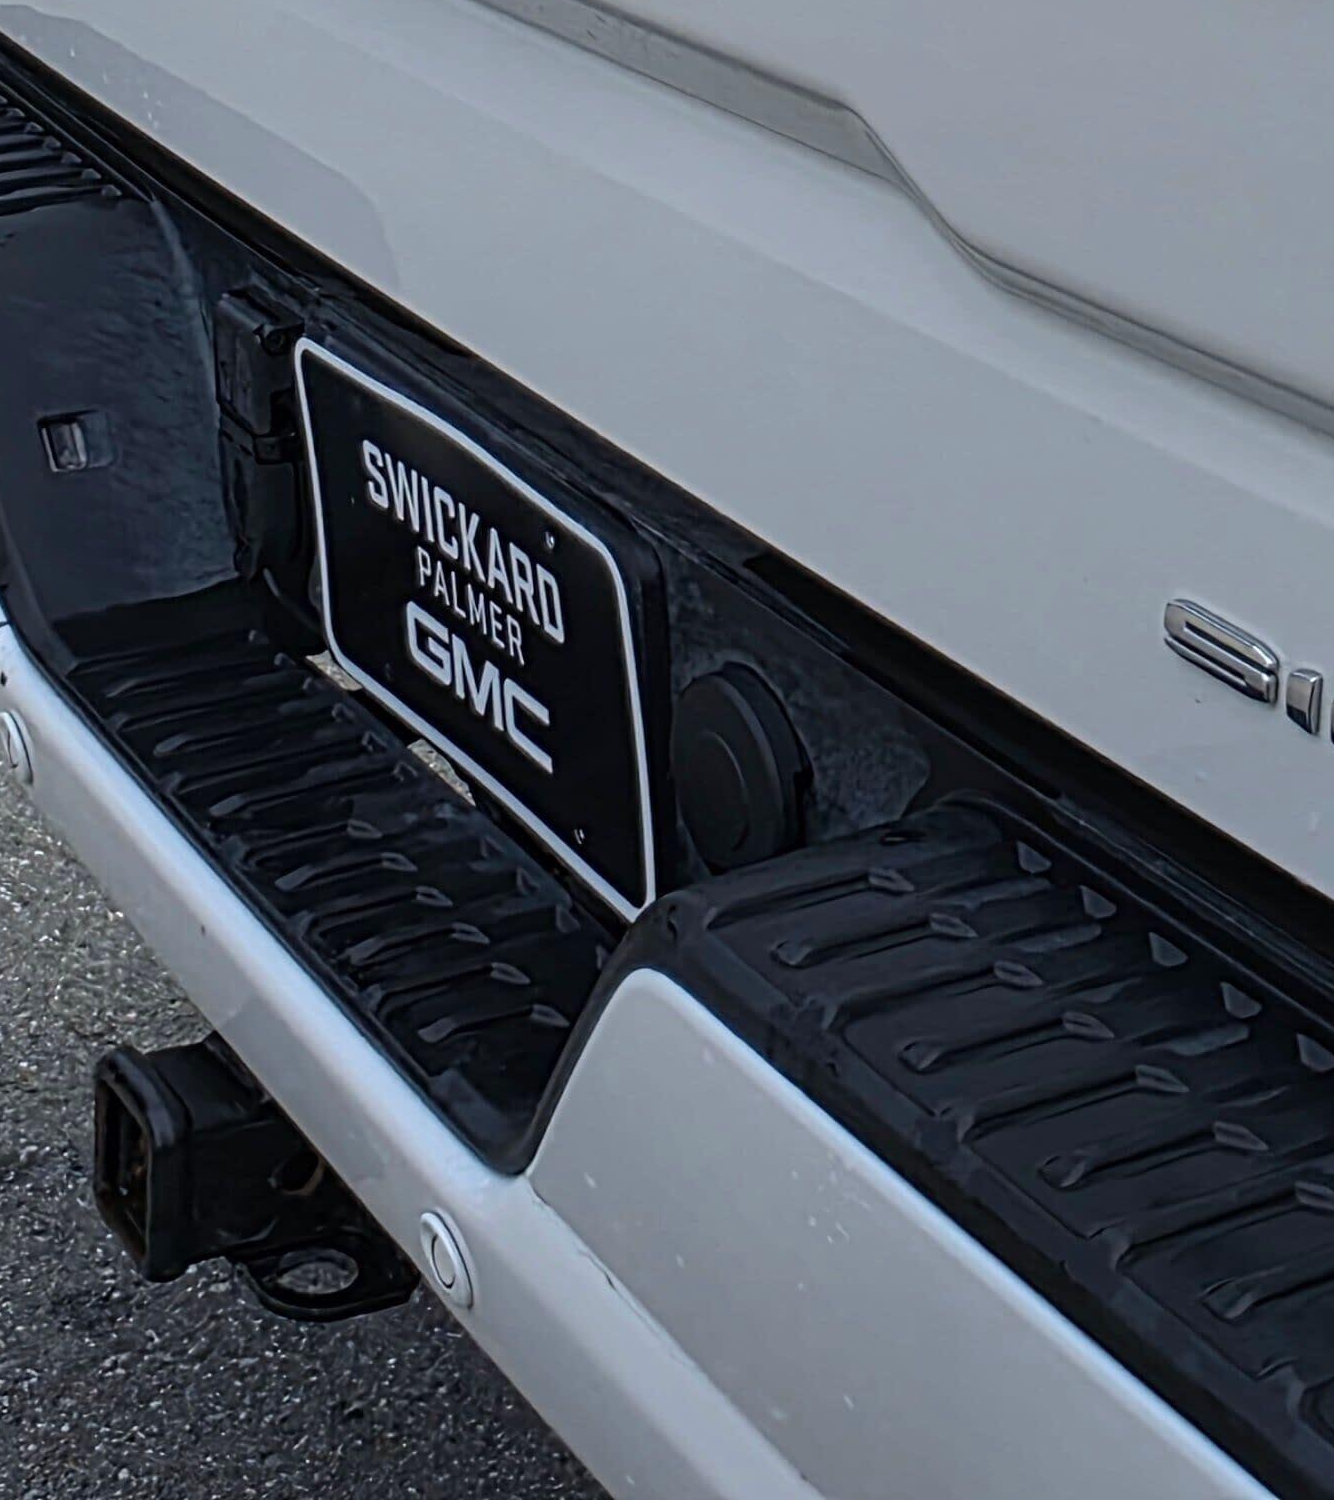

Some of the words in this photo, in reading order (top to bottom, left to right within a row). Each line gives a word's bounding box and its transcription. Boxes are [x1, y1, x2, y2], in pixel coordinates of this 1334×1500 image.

[361, 438, 566, 645] SWICKARD
[416, 544, 526, 667] PALMER
[405, 600, 554, 775] GMC
